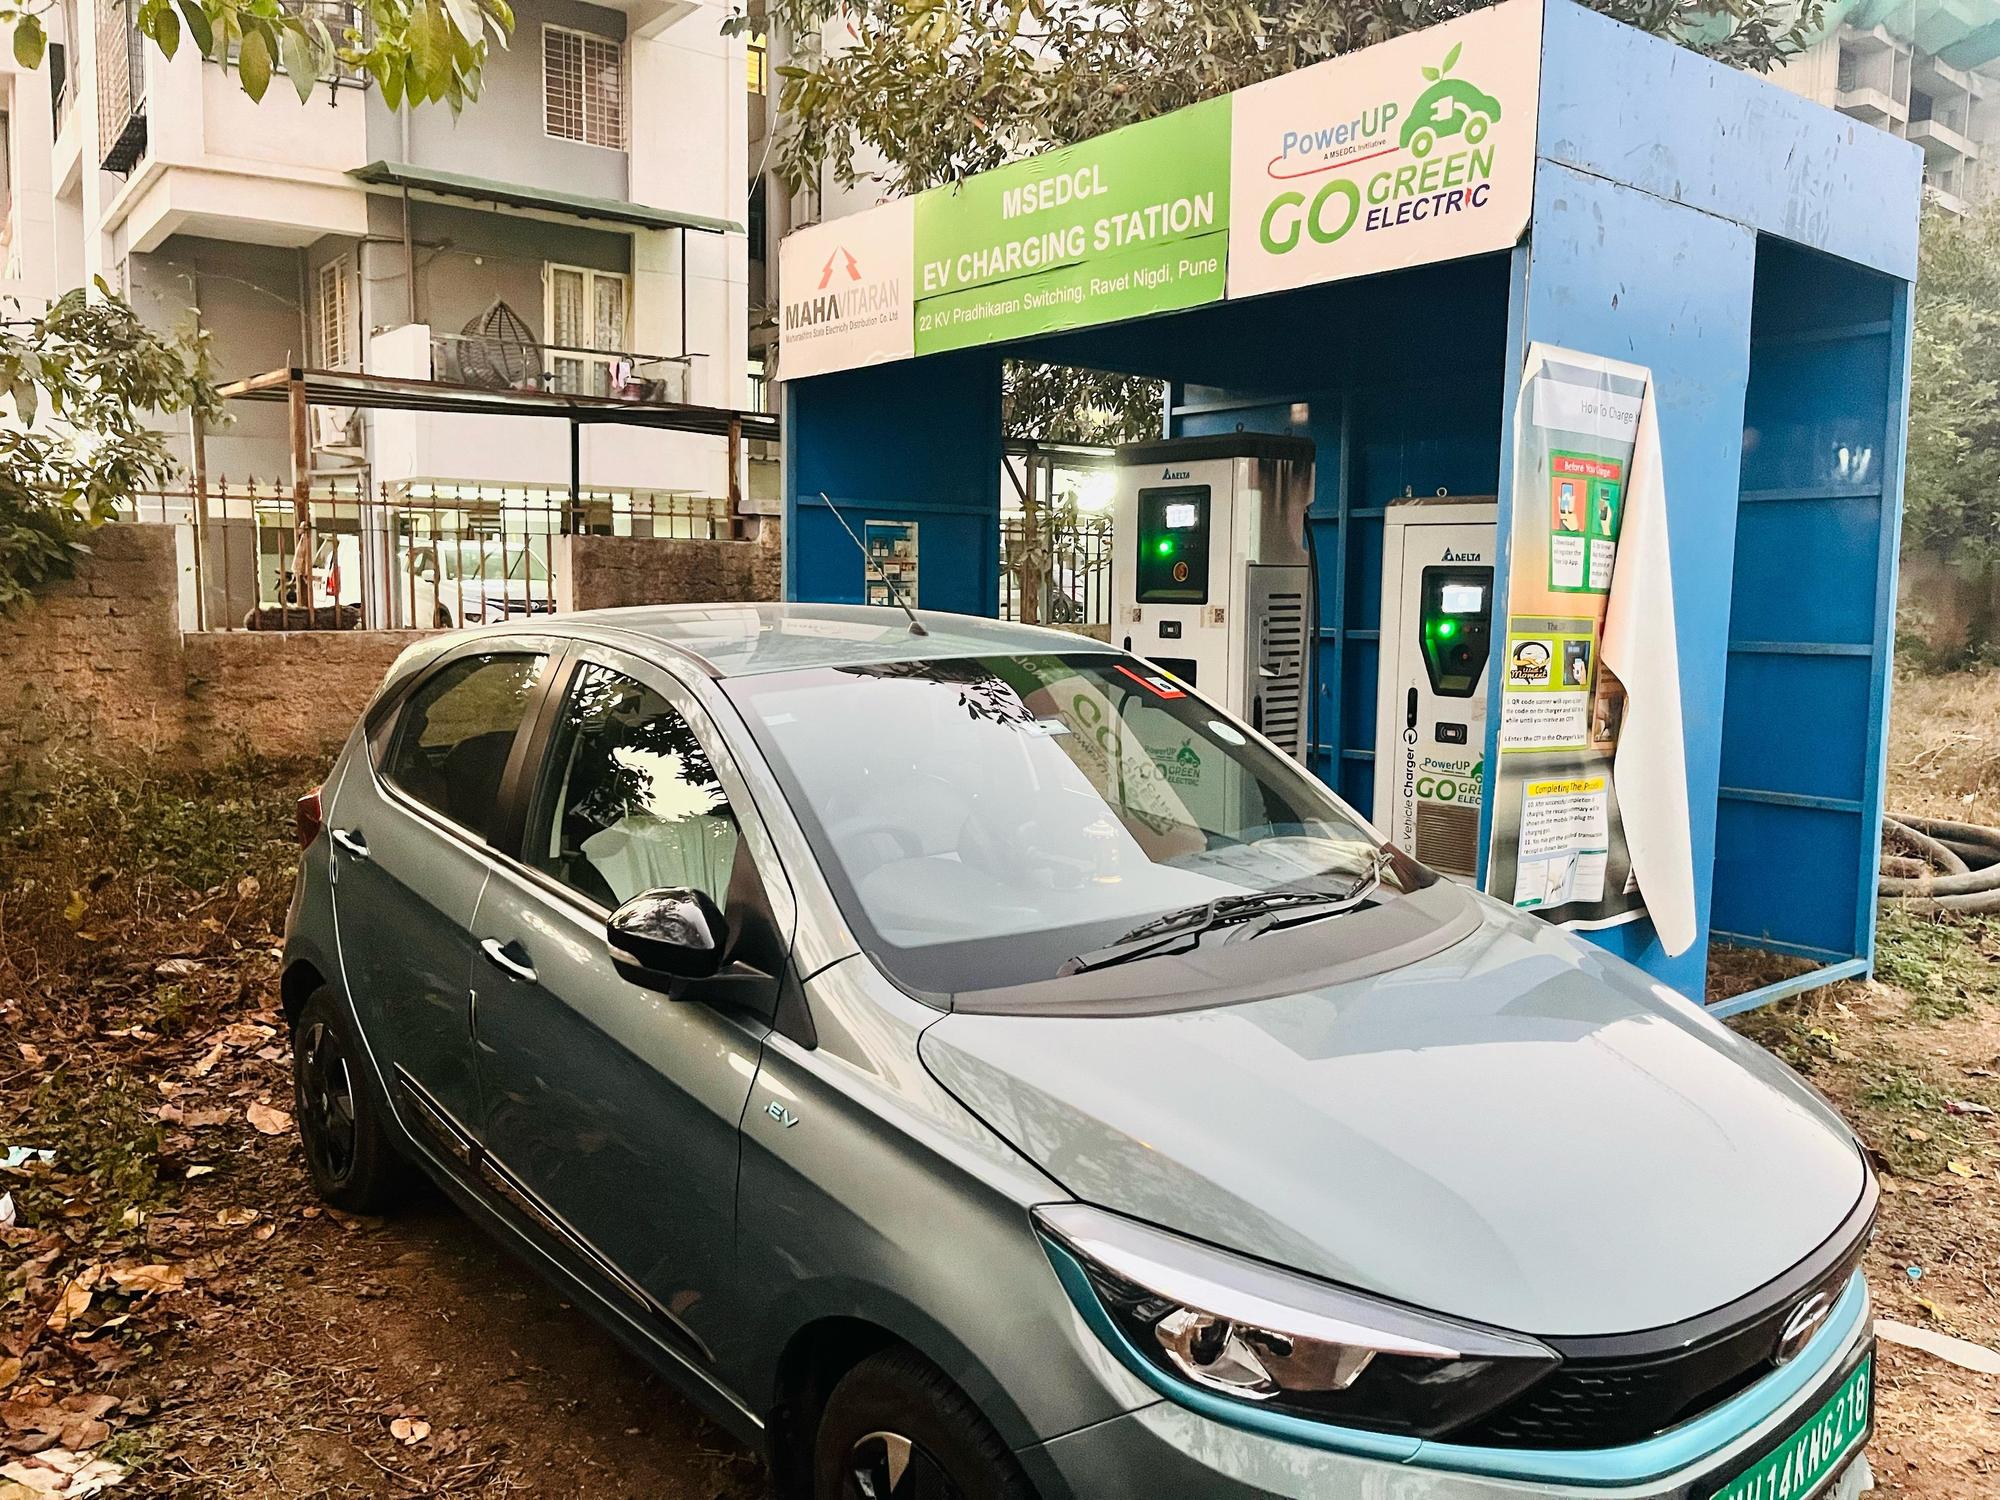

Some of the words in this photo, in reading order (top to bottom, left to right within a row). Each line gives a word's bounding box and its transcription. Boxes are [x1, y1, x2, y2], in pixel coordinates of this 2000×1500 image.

[1282, 103, 1398, 159] PowerUP
[1330, 146, 1357, 159] MSEDCL
[1002, 164, 1108, 220] MSEDCL
[1367, 144, 1495, 205] GREEN
[1260, 178, 1361, 255] GO
[1365, 183, 1490, 232] ELECTRIC
[923, 259, 951, 291] EV
[957, 225, 1086, 283] CHARGING
[1093, 191, 1214, 251] STATION
[919, 314, 932, 332] 22
[935, 311, 951, 329] KV
[953, 298, 1020, 324] Pradhikaran
[1023, 284, 1086, 310] Switching,
[1090, 272, 1130, 296] Ravet
[1133, 263, 1174, 289] Nigdi,
[1178, 257, 1218, 279] Pune
[849, 316, 878, 330] Distribution
[1581, 399, 1598, 415] How
[1609, 406, 1634, 424] Charge
[1564, 460, 1584, 472] Before
[1455, 553, 1481, 561] DELTA
[1403, 747, 1416, 798] Charger
[1424, 757, 1471, 771] PowerUP
[1416, 776, 1457, 801] GO
[1535, 783, 1570, 795] Completing
[1570, 781, 1582, 791] The
[1403, 800, 1413, 840] Vehicle
[1729, 1373, 1866, 1500] H14KN6218
